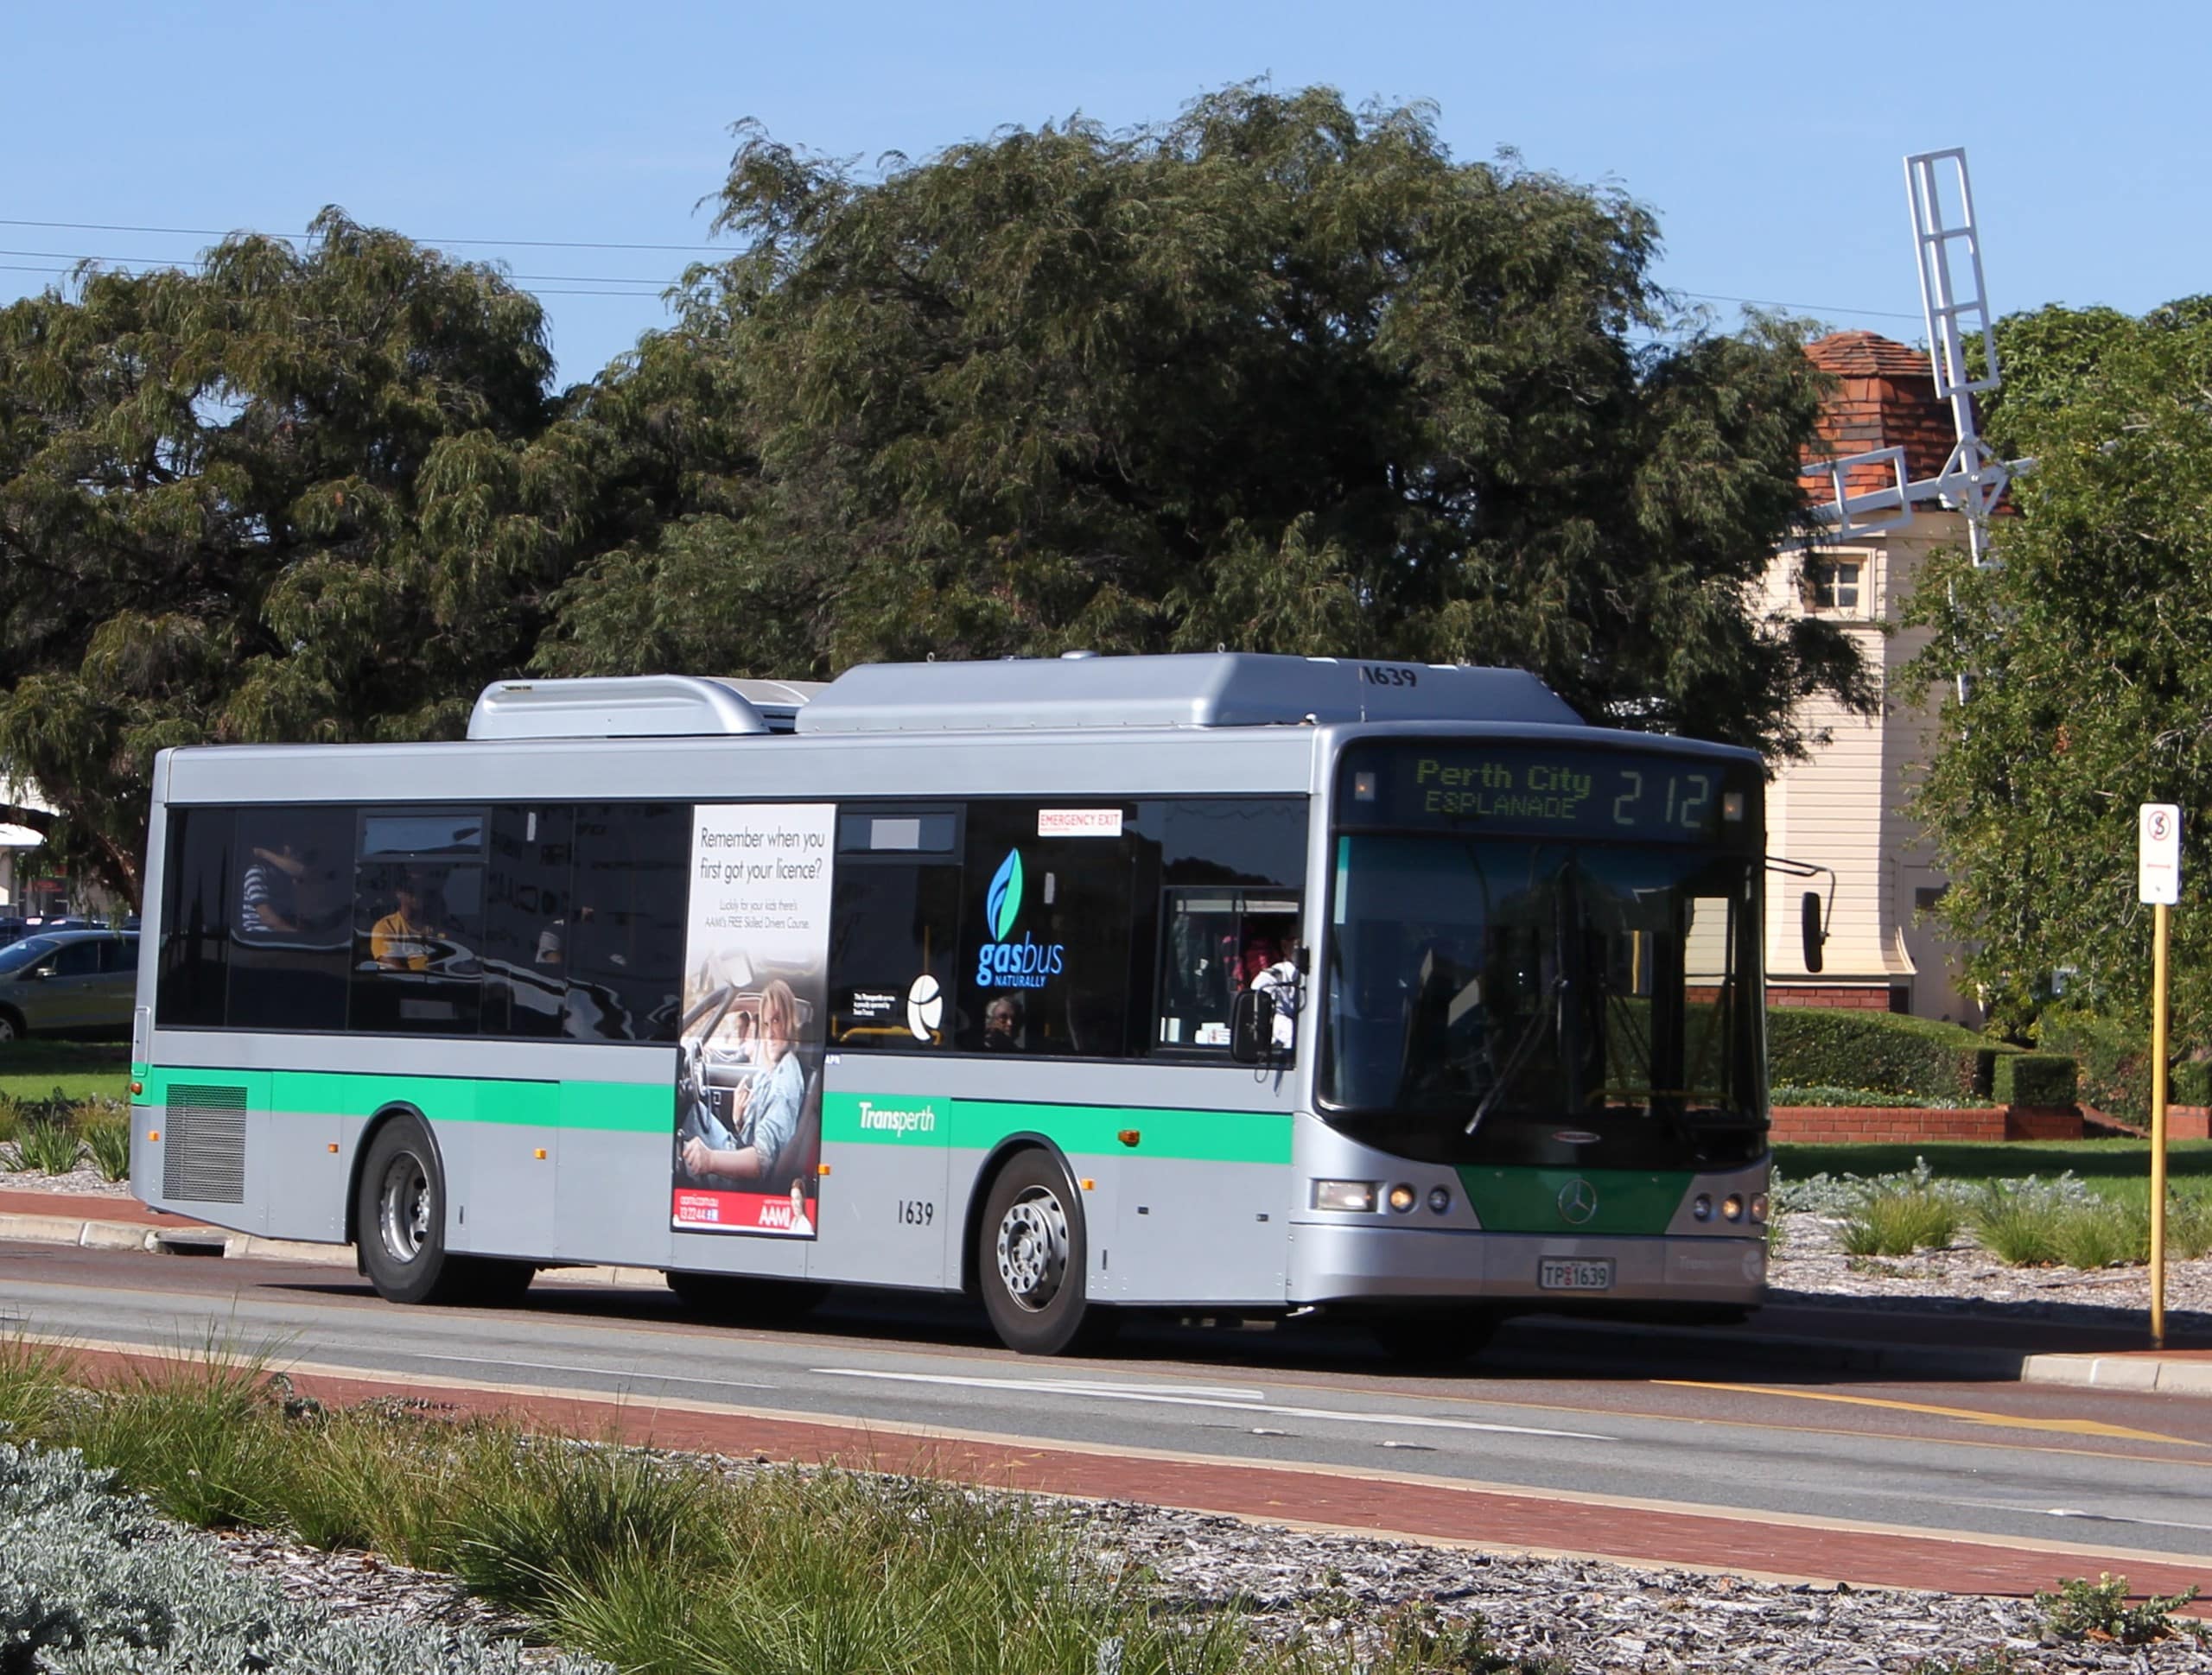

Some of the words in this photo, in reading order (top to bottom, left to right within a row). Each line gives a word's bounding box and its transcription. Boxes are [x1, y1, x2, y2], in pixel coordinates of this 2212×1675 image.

[1363, 666, 1417, 688] 1639
[1416, 759, 1511, 789] Perth
[1528, 765, 1592, 799] City
[1426, 790, 1578, 819] ESPLANADE
[1040, 814, 1095, 827] EMERGENCY
[1098, 814, 1120, 827] EXIT
[701, 826, 764, 847] Remember
[767, 826, 799, 847] when
[803, 833, 825, 853] you
[700, 857, 721, 879] first
[724, 860, 744, 885] got
[747, 865, 773, 884] your
[777, 857, 823, 879] licence?
[976, 930, 1065, 987] gasbus
[994, 974, 1047, 988] NATURALLY
[859, 1101, 936, 1139] Transperth
[758, 1204, 791, 1228] AAMI
[898, 1200, 934, 1227] 1639
[1544, 1266, 1563, 1285] TP
[1574, 1266, 1606, 1286] 1639
